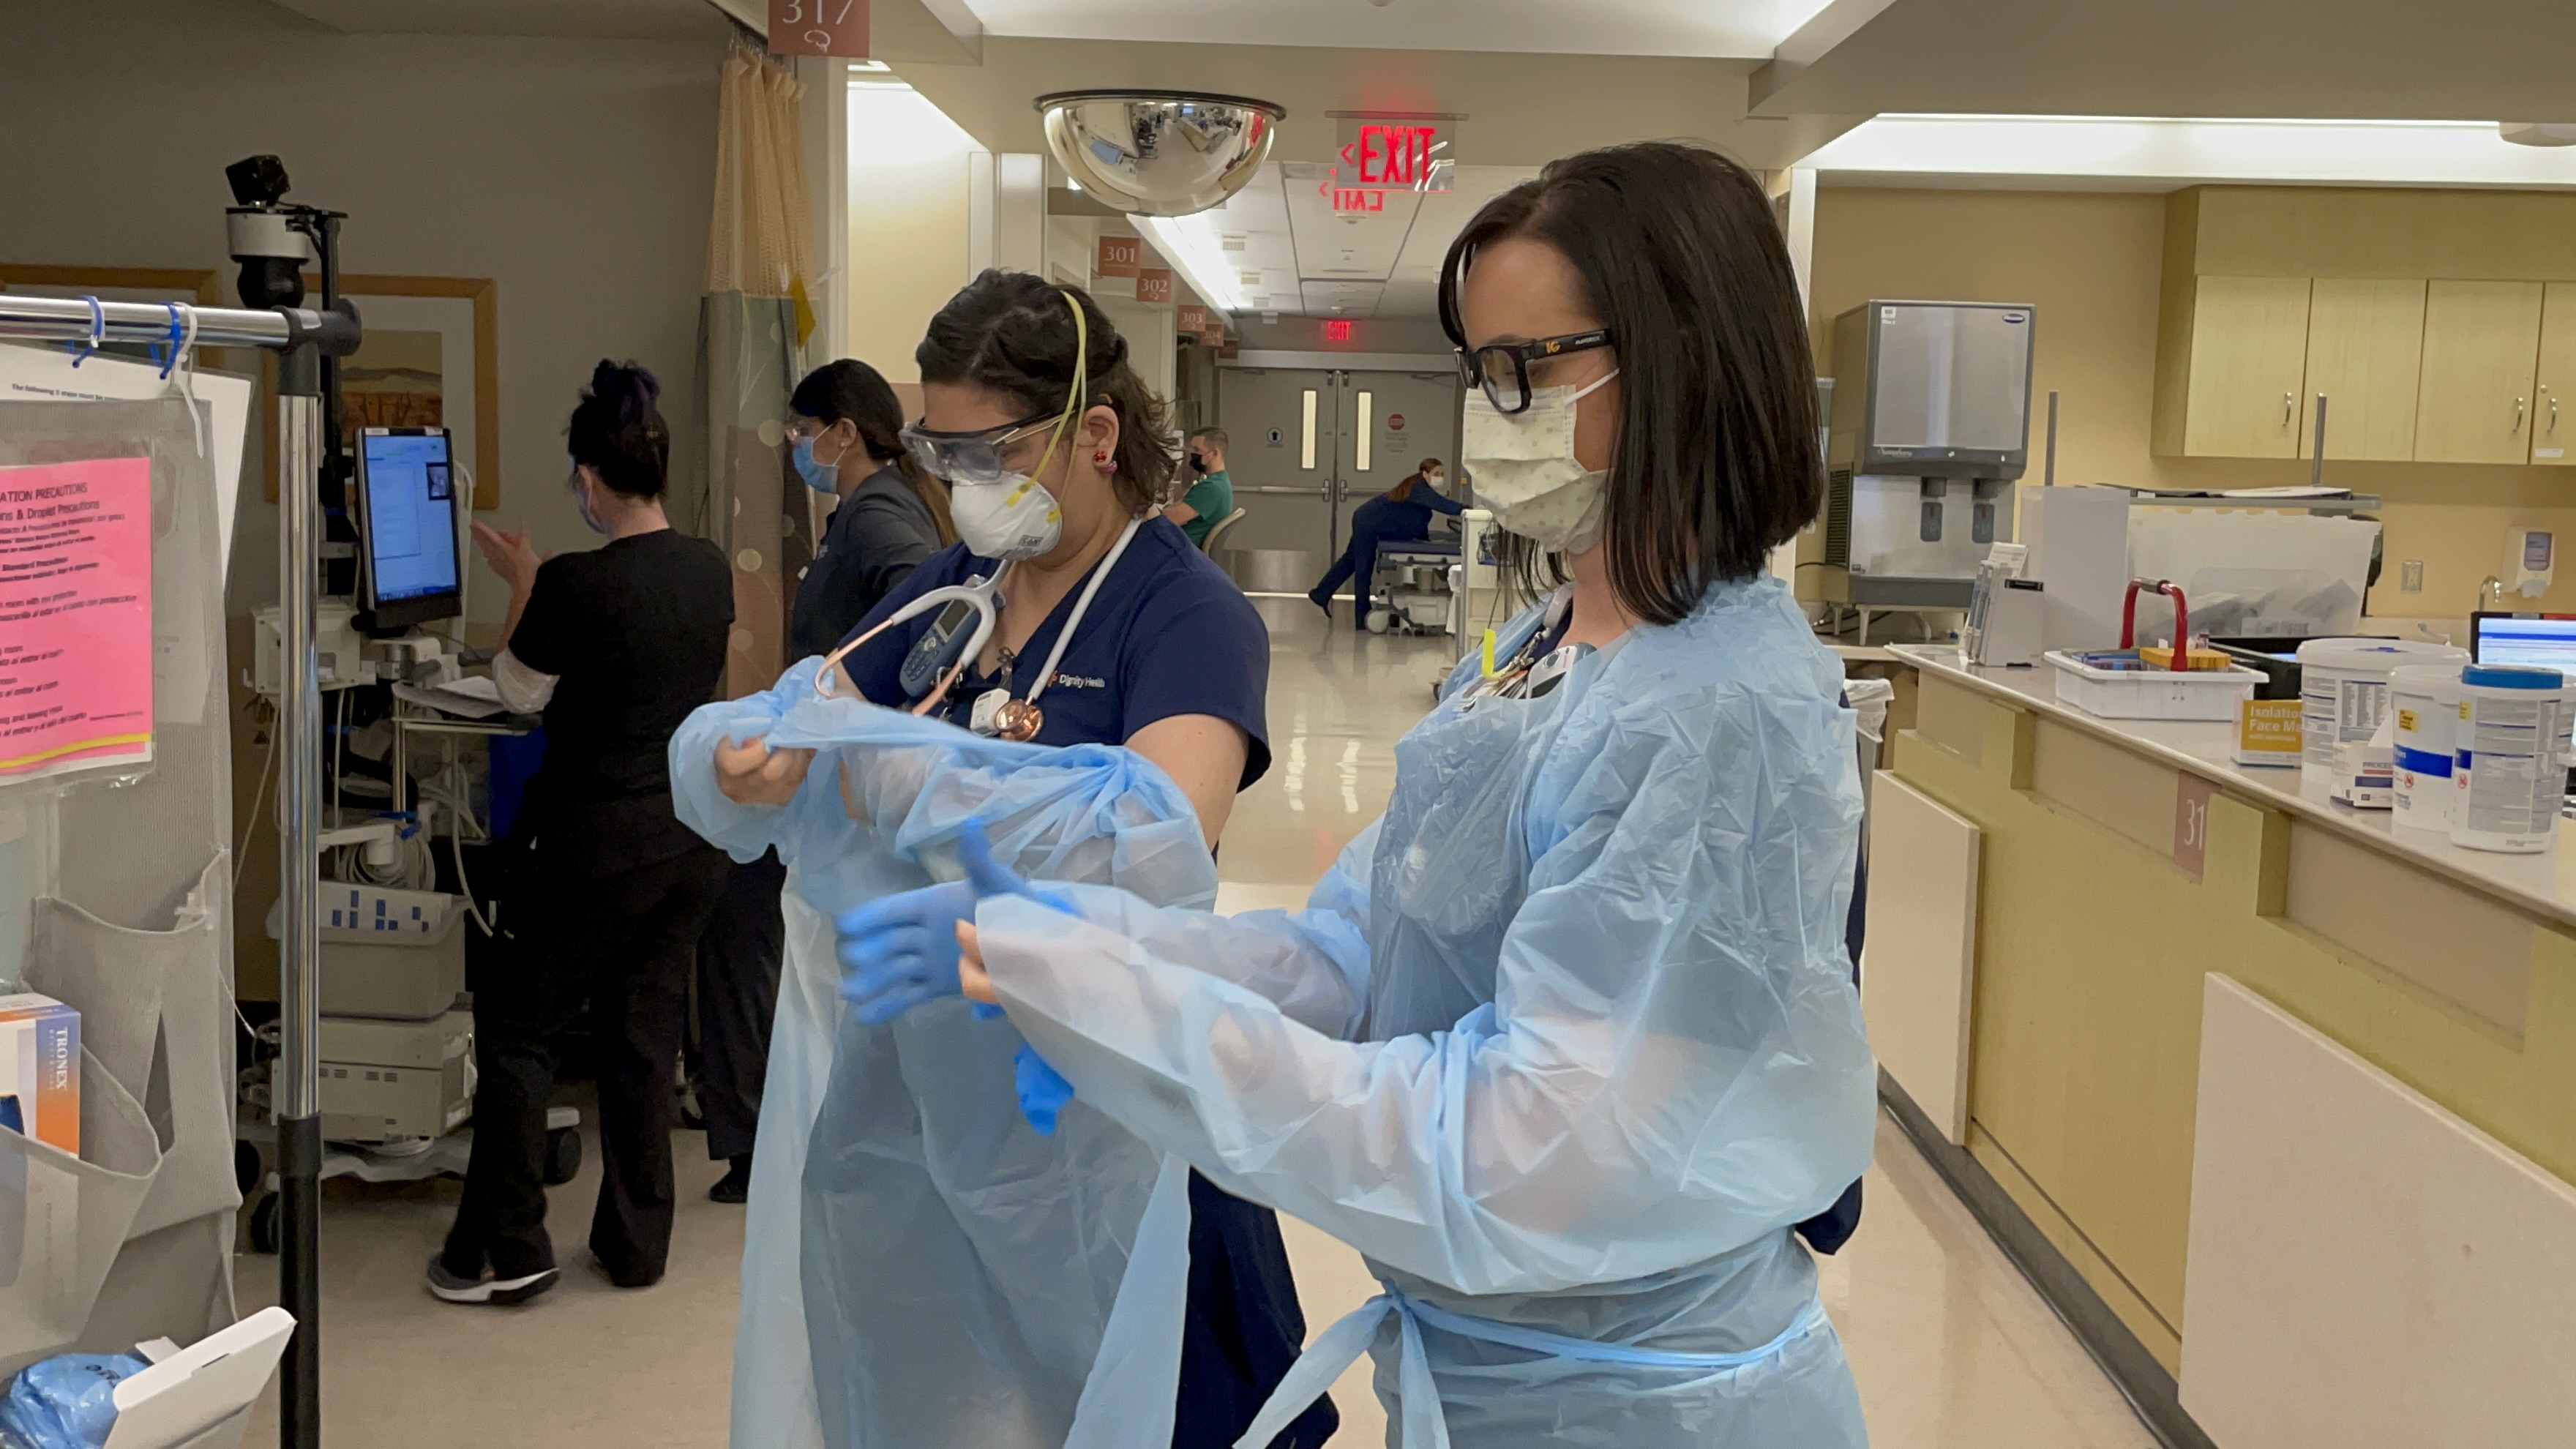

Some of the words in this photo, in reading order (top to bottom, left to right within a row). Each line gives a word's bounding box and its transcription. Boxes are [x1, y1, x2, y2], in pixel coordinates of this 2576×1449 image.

[1359, 125, 1437, 183] EXIT
[1104, 246, 1135, 263] 301
[1142, 278, 1167, 293] 302
[1181, 312, 1202, 324] 303
[1328, 321, 1351, 340] EXIT
[35, 482, 88, 500] PRECAUTIONS
[1059, 674, 1084, 688] Dignity
[1085, 677, 1106, 688] Health
[2251, 706, 2302, 718] Isolatio
[2250, 719, 2280, 731] Face
[56, 1026, 68, 1091] TRONEX
